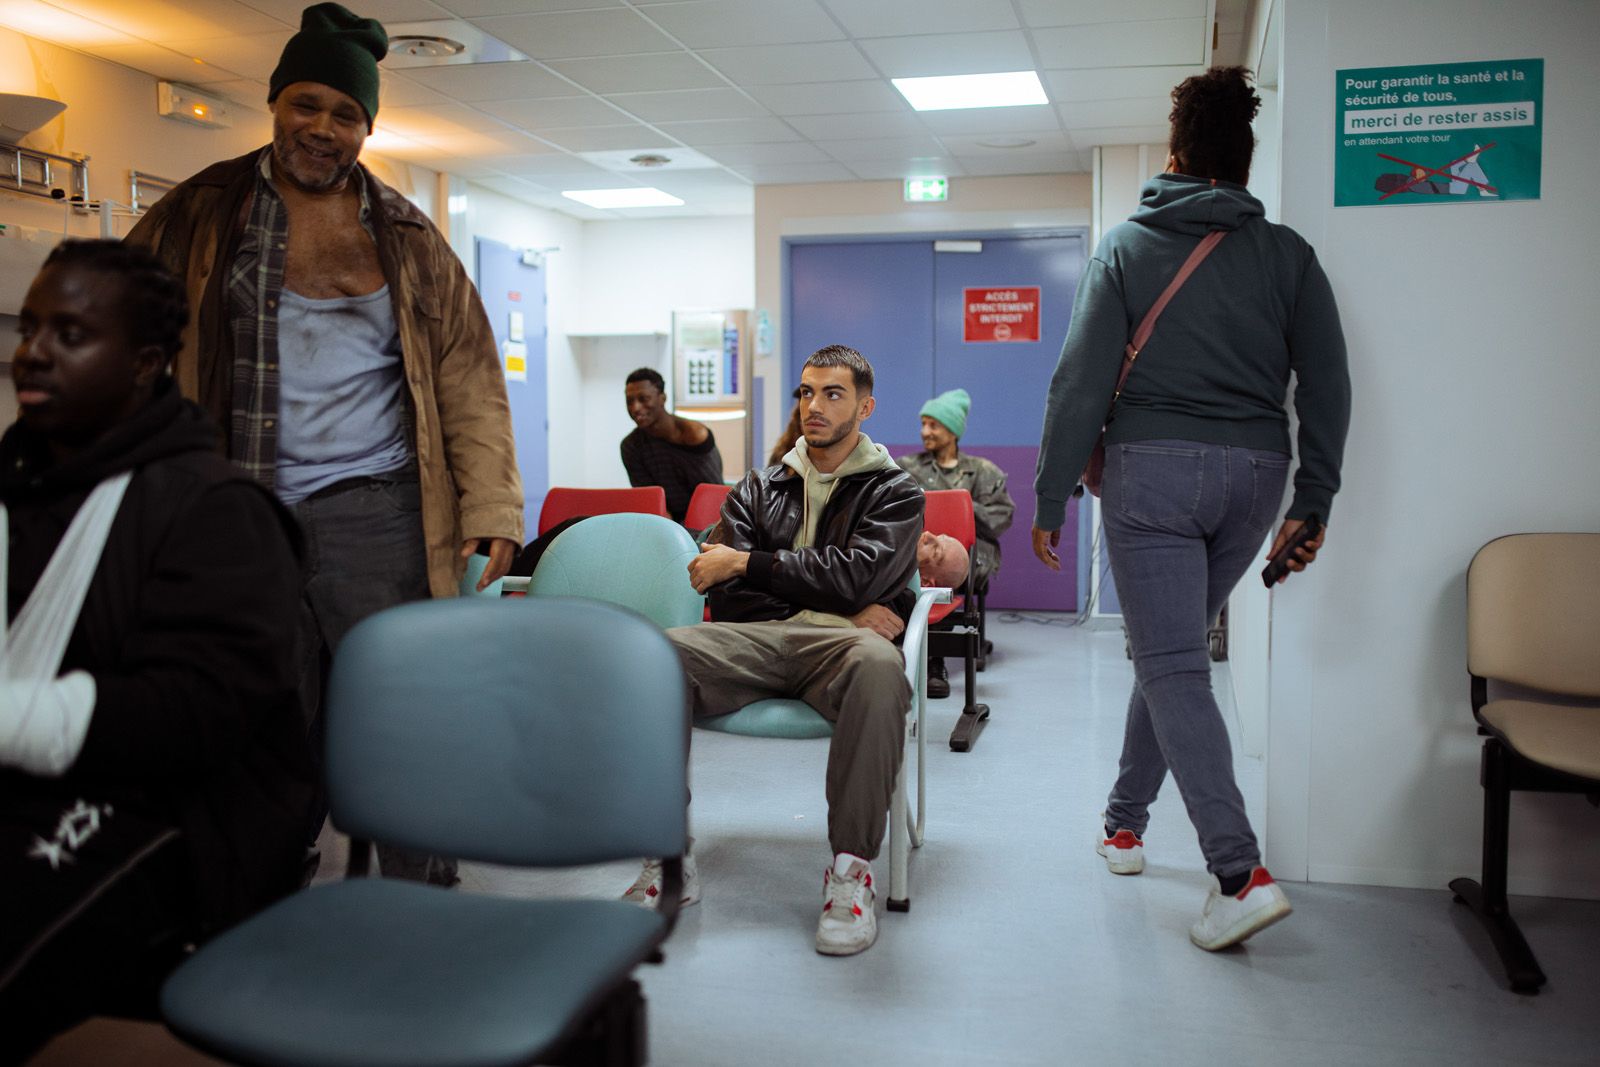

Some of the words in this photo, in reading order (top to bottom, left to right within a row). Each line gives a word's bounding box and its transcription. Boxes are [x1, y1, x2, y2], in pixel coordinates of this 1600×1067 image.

[1345, 79, 1377, 90] Pour
[1381, 74, 1434, 91] garantir
[1437, 73, 1450, 85] la
[1453, 70, 1491, 84] santé
[1495, 70, 1509, 81] et
[1512, 69, 1525, 81] la
[1345, 93, 1399, 106] sécurité
[1402, 92, 1419, 103] de
[1351, 113, 1397, 128] merci
[1403, 113, 1423, 126] de
[1428, 111, 1478, 125] rester
[1483, 107, 1527, 122] assis
[1359, 136, 1403, 146] attendant
[1405, 135, 1429, 144] votre
[1431, 134, 1451, 142] tour
[969, 302, 1034, 313] STRICTEMENT
[980, 313, 1023, 324] INTERDIT
